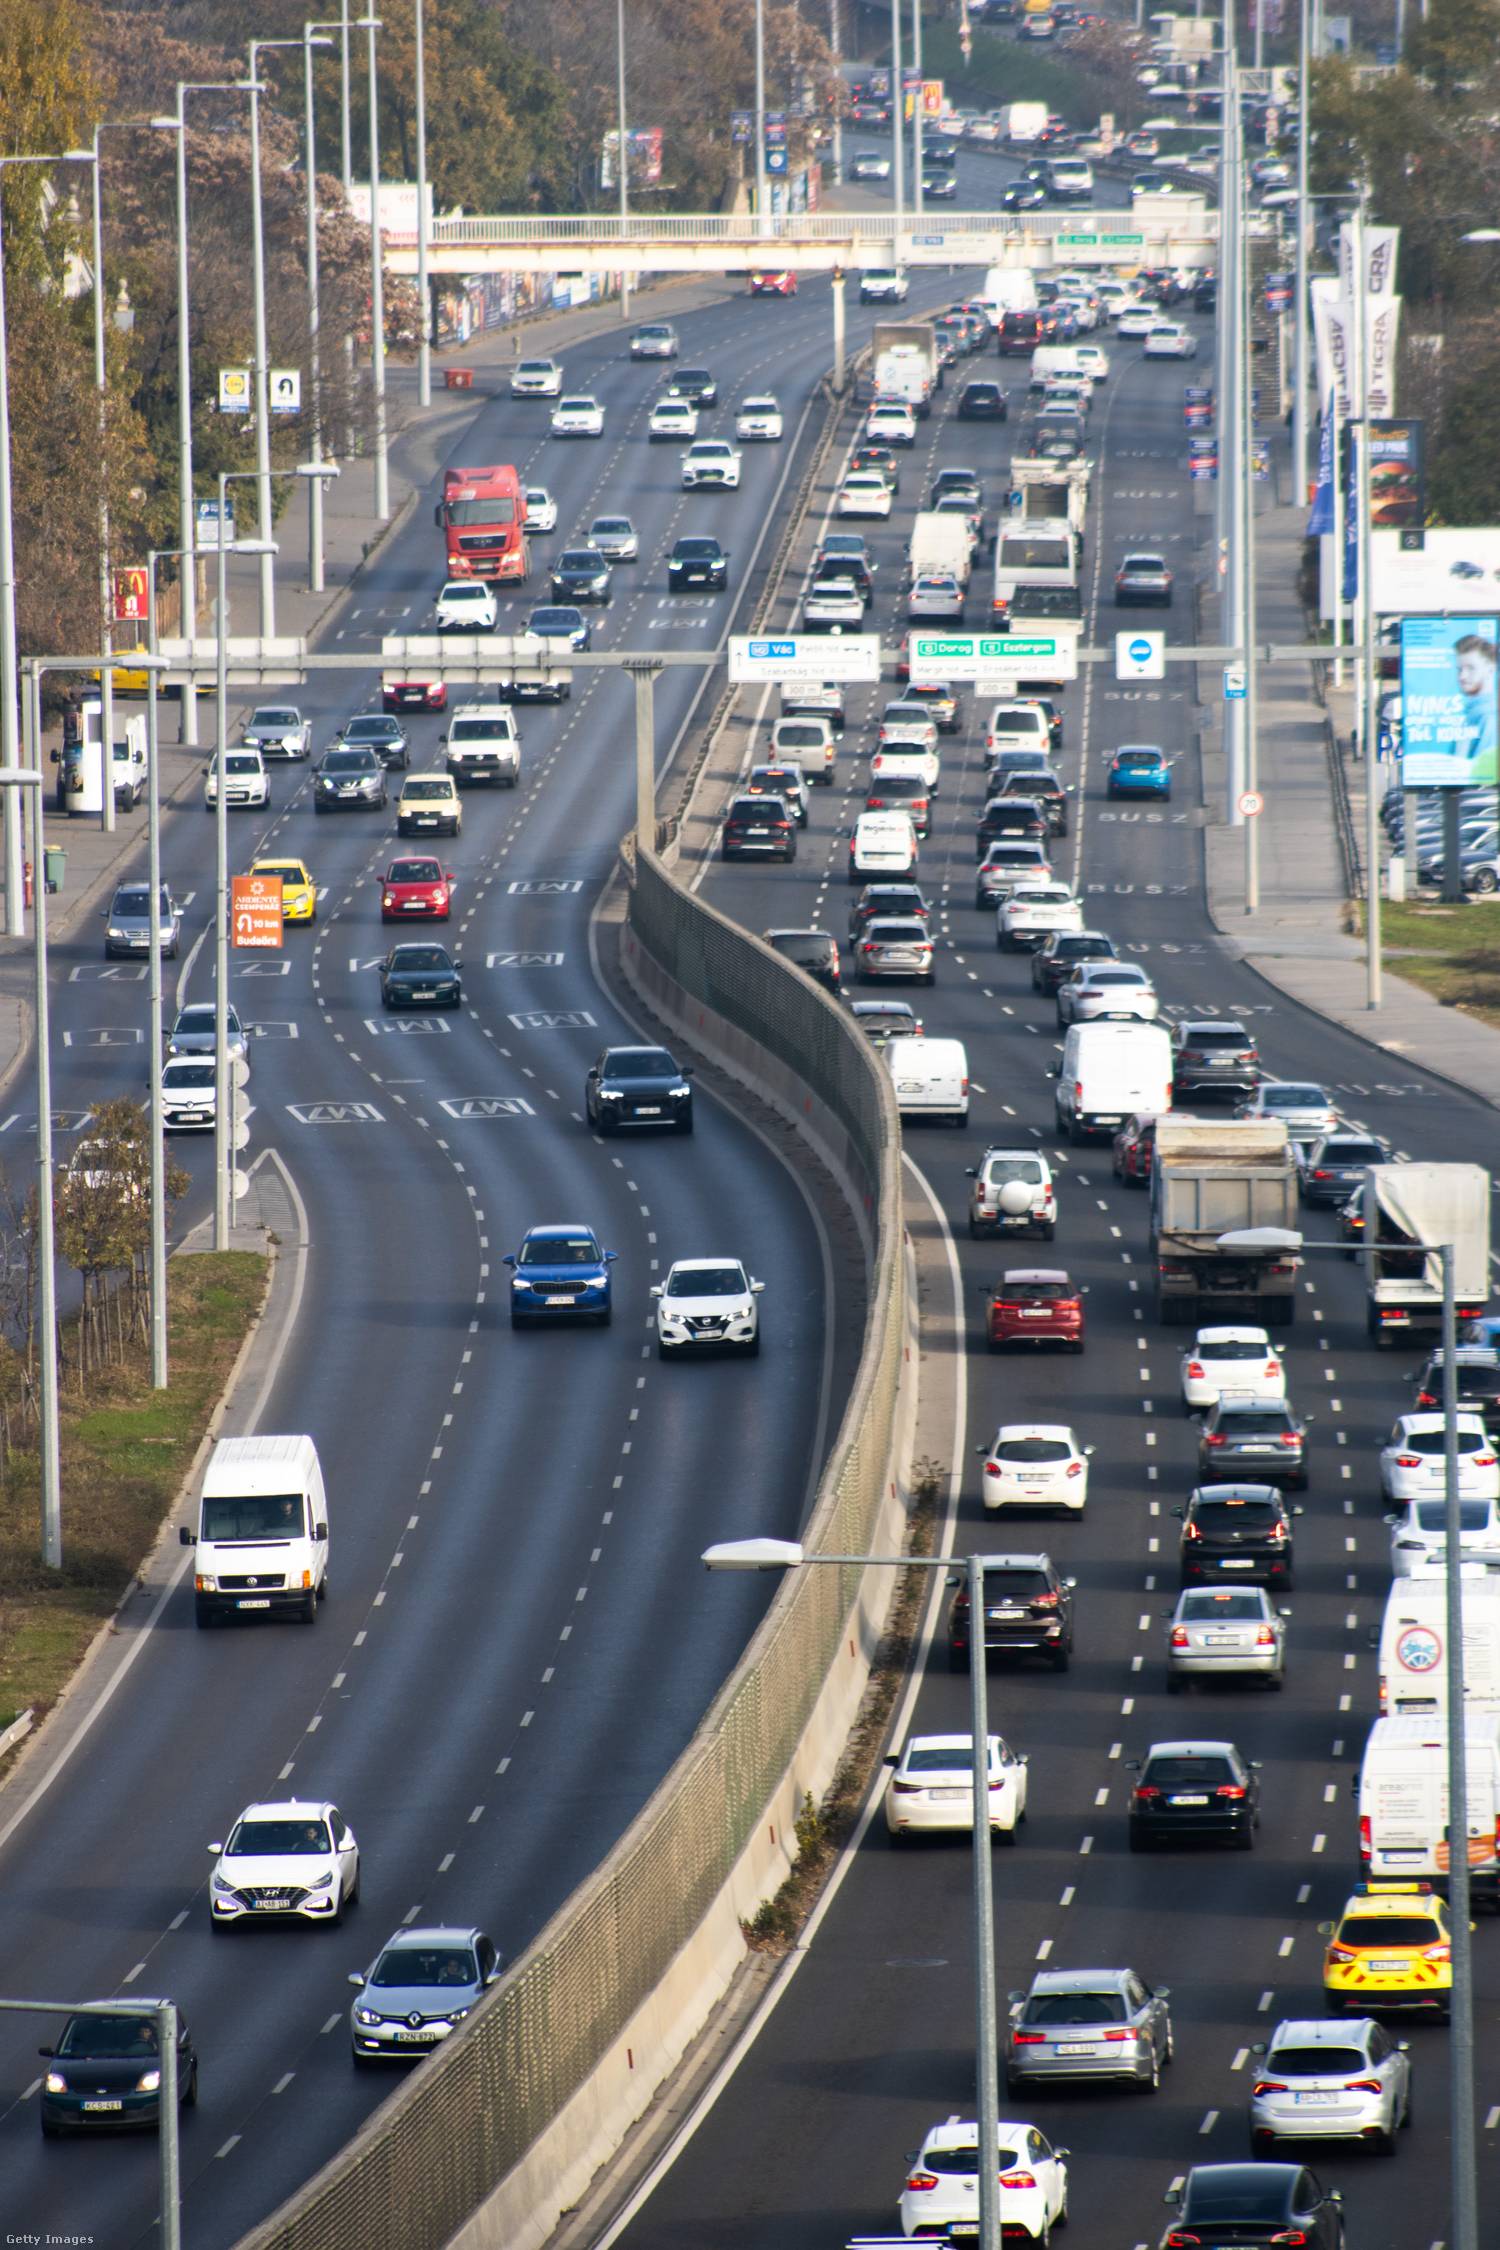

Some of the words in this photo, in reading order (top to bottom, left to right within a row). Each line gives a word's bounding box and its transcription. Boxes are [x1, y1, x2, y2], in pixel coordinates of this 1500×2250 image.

[1368, 239, 1388, 294] GRA
[772, 644, 792, 654] Vác
[939, 643, 971, 654] Dorog
[1003, 642, 1052, 653] Esztergom
[1104, 691, 1184, 701] BUSZ
[1244, 799, 1257, 809] 70
[1099, 812, 1188, 823] BUSZ
[1088, 884, 1188, 896] BUSZ
[253, 920, 264, 928] 10
[265, 920, 279, 928] km
[236, 935, 278, 945] Budaörs
[1126, 943, 1206, 953] USZ
[309, 1104, 369, 1121] M7
[461, 1099, 523, 1116] M7
